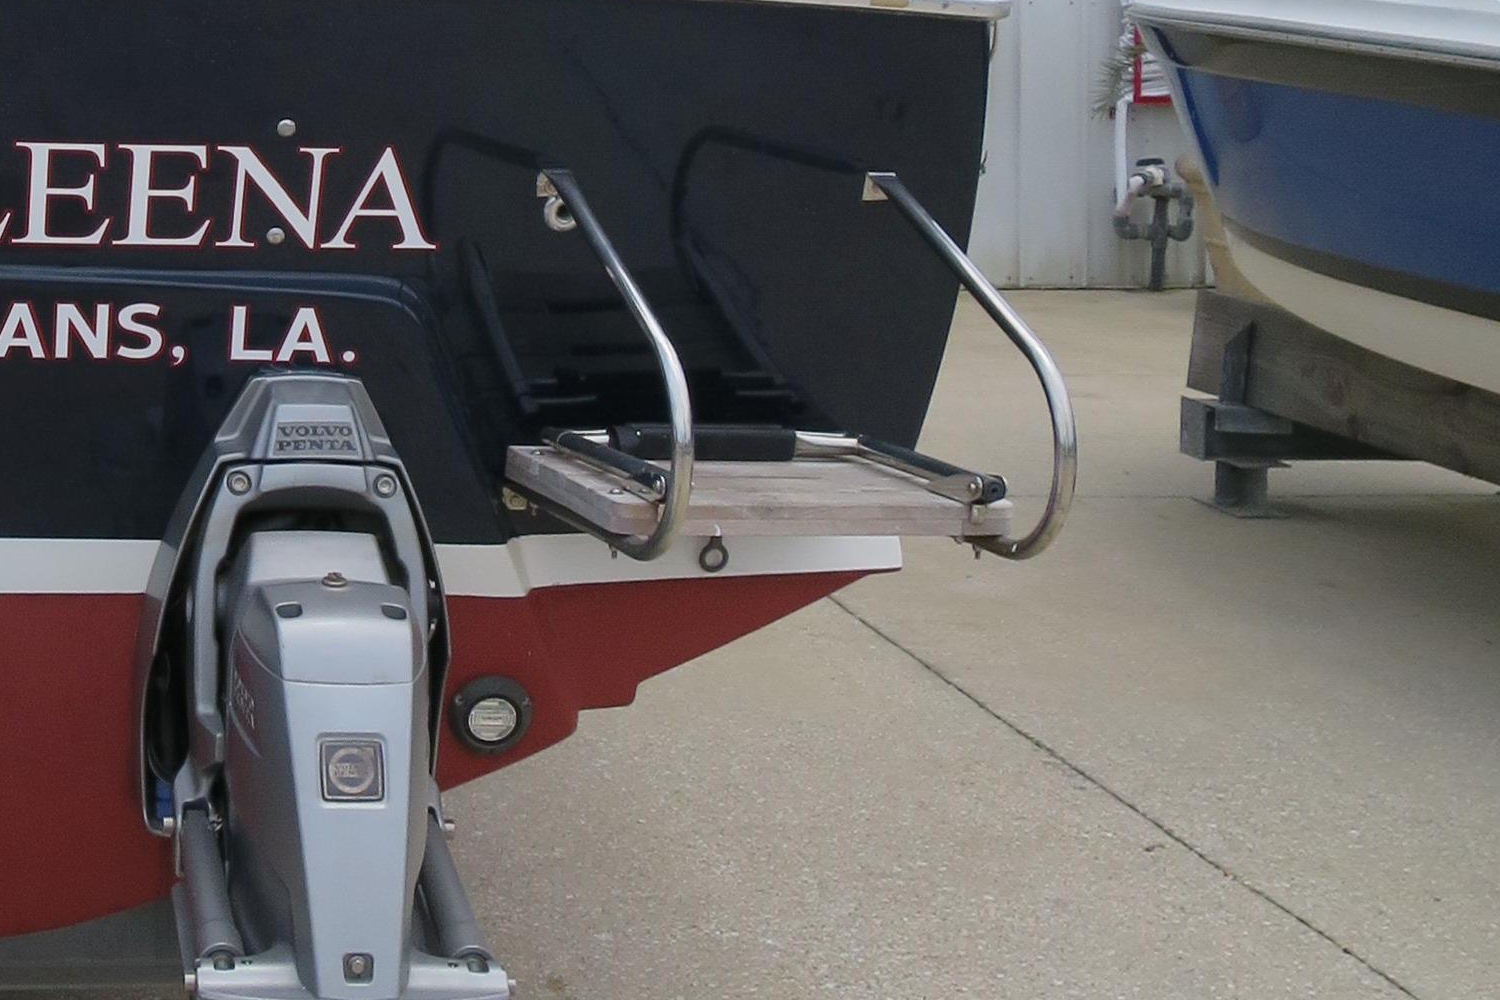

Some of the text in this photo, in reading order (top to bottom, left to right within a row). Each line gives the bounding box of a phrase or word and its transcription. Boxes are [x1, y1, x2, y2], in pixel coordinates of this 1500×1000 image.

[228, 304, 357, 364] LA.
[277, 425, 353, 437] VOLVO
[276, 440, 357, 451] PENTA
